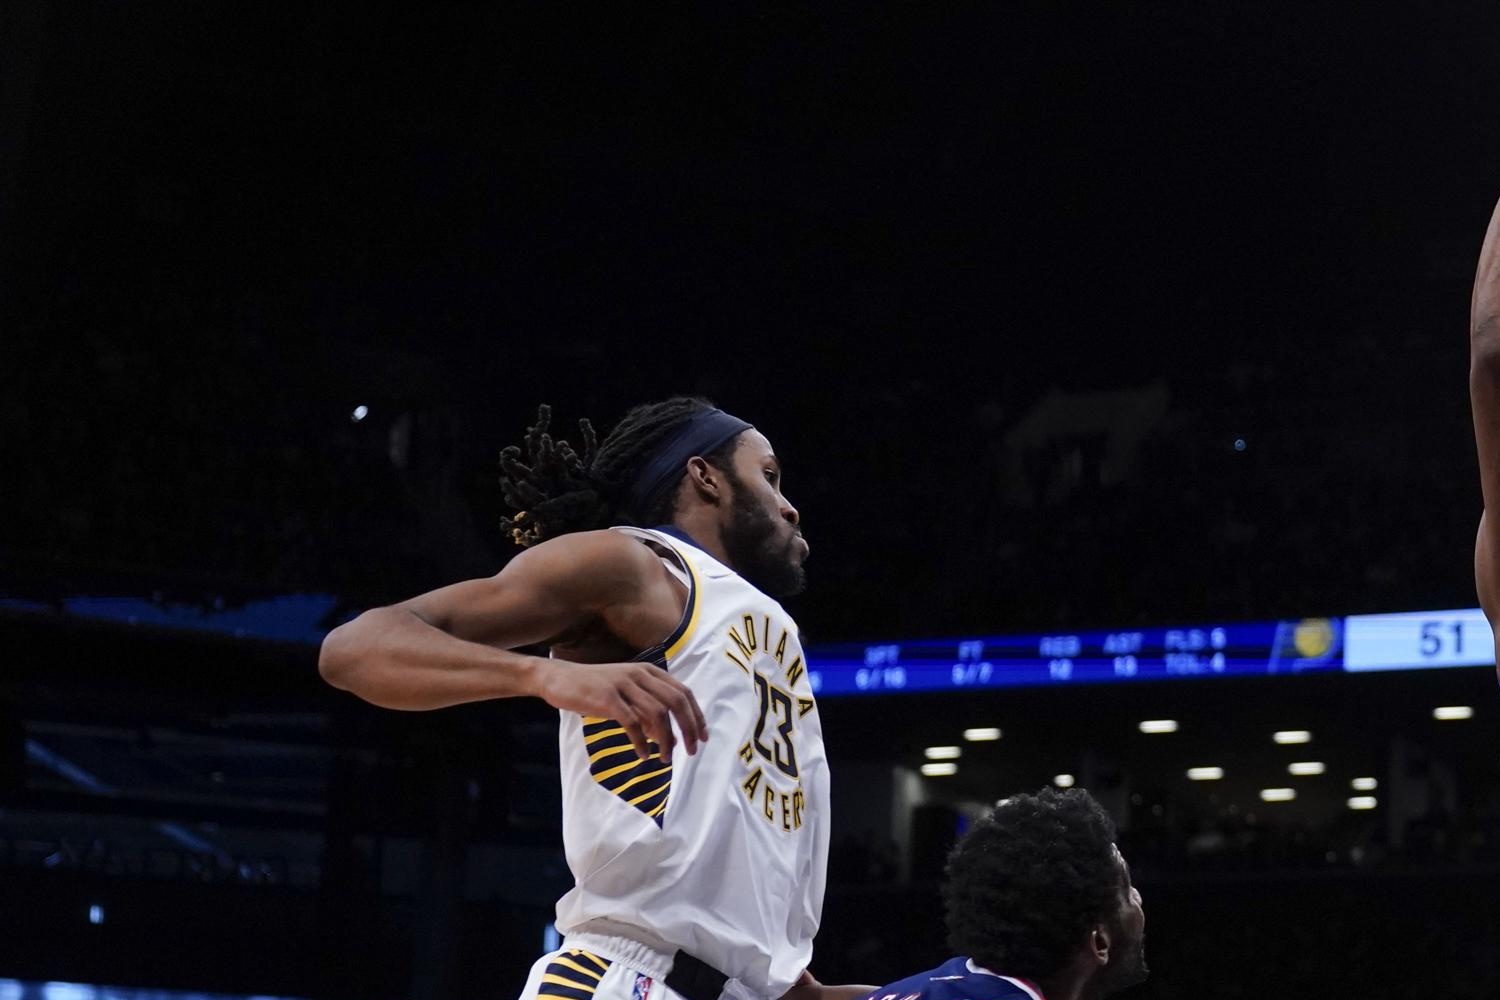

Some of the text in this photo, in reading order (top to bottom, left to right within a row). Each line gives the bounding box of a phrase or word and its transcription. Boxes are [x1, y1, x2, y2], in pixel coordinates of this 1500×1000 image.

[726, 613, 815, 718] INDIANA
[1420, 620, 1464, 657] 51
[753, 671, 801, 780] 23
[738, 740, 805, 833] PACER
